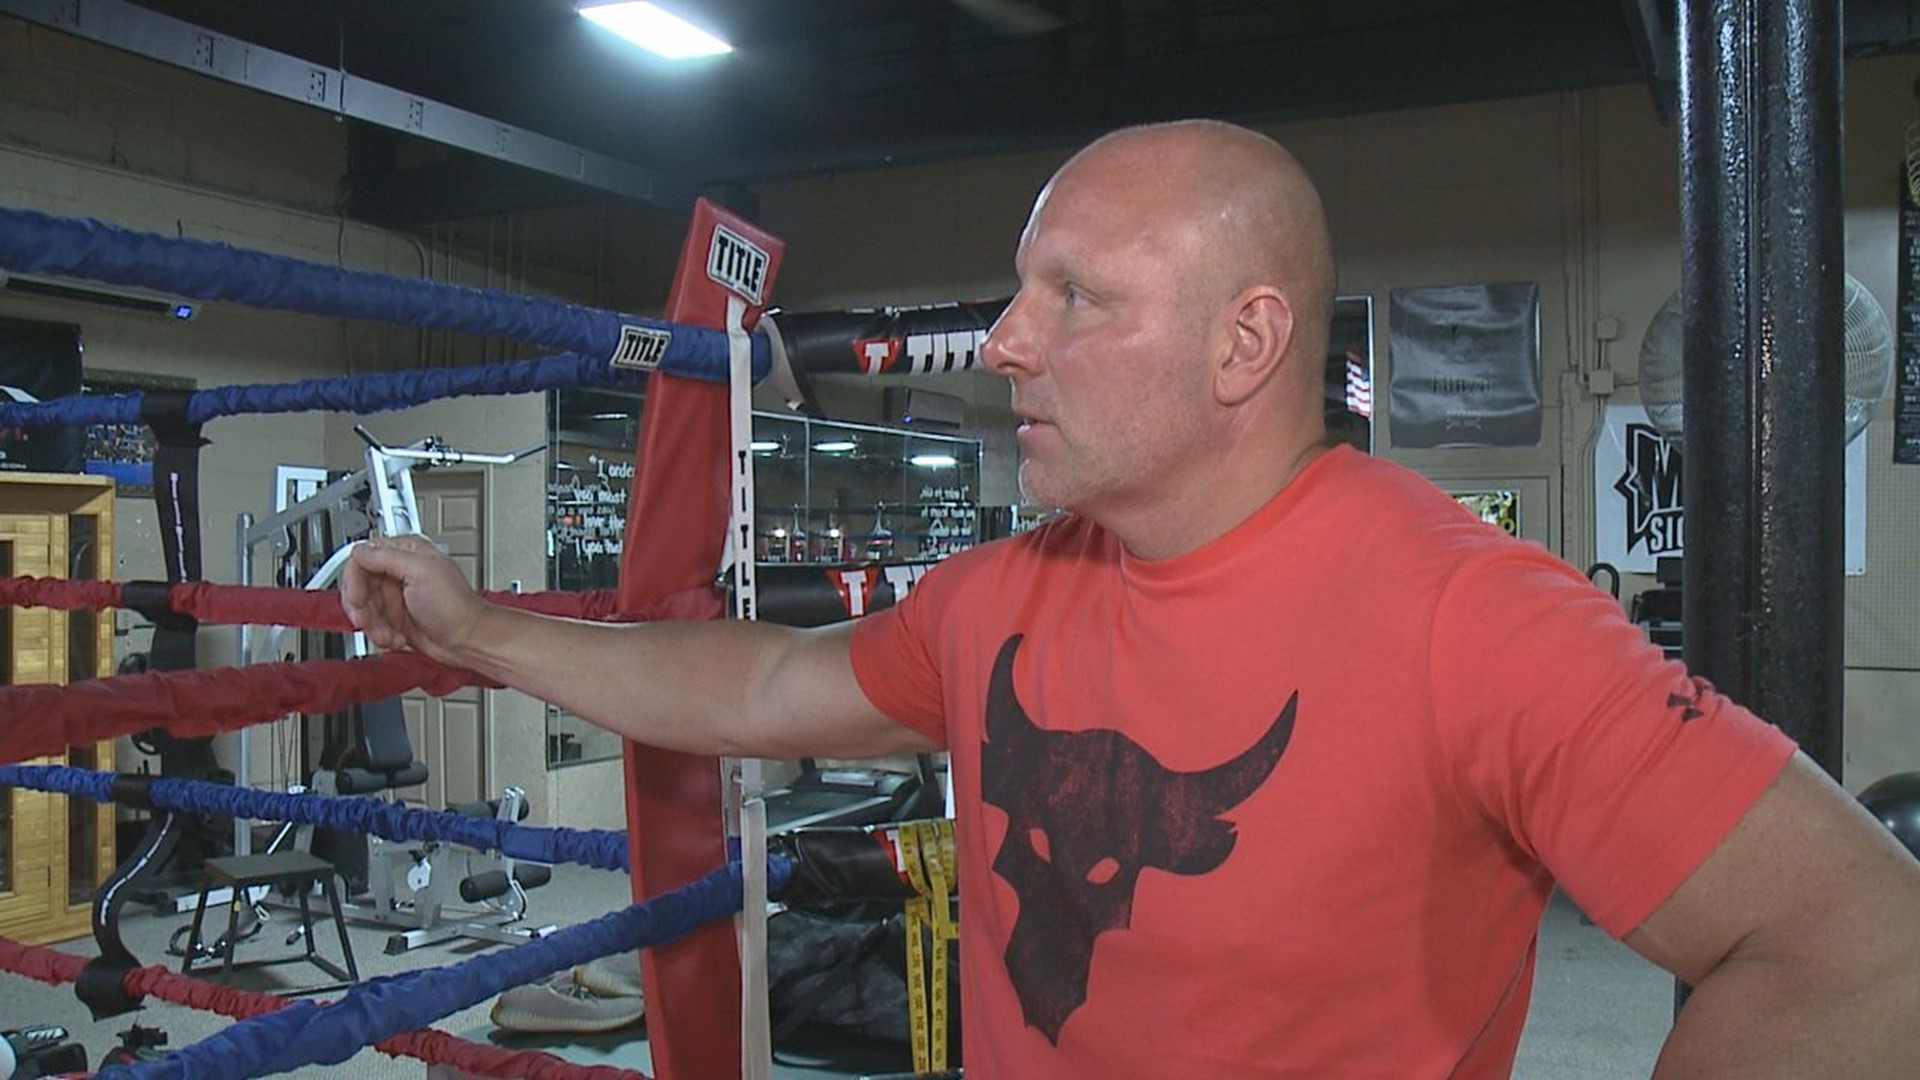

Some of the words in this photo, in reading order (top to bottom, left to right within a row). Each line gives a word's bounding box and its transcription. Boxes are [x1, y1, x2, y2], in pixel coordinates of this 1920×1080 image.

[716, 235, 762, 293] TITLE
[624, 334, 665, 363] TITLE
[738, 451, 751, 620] TITLE
